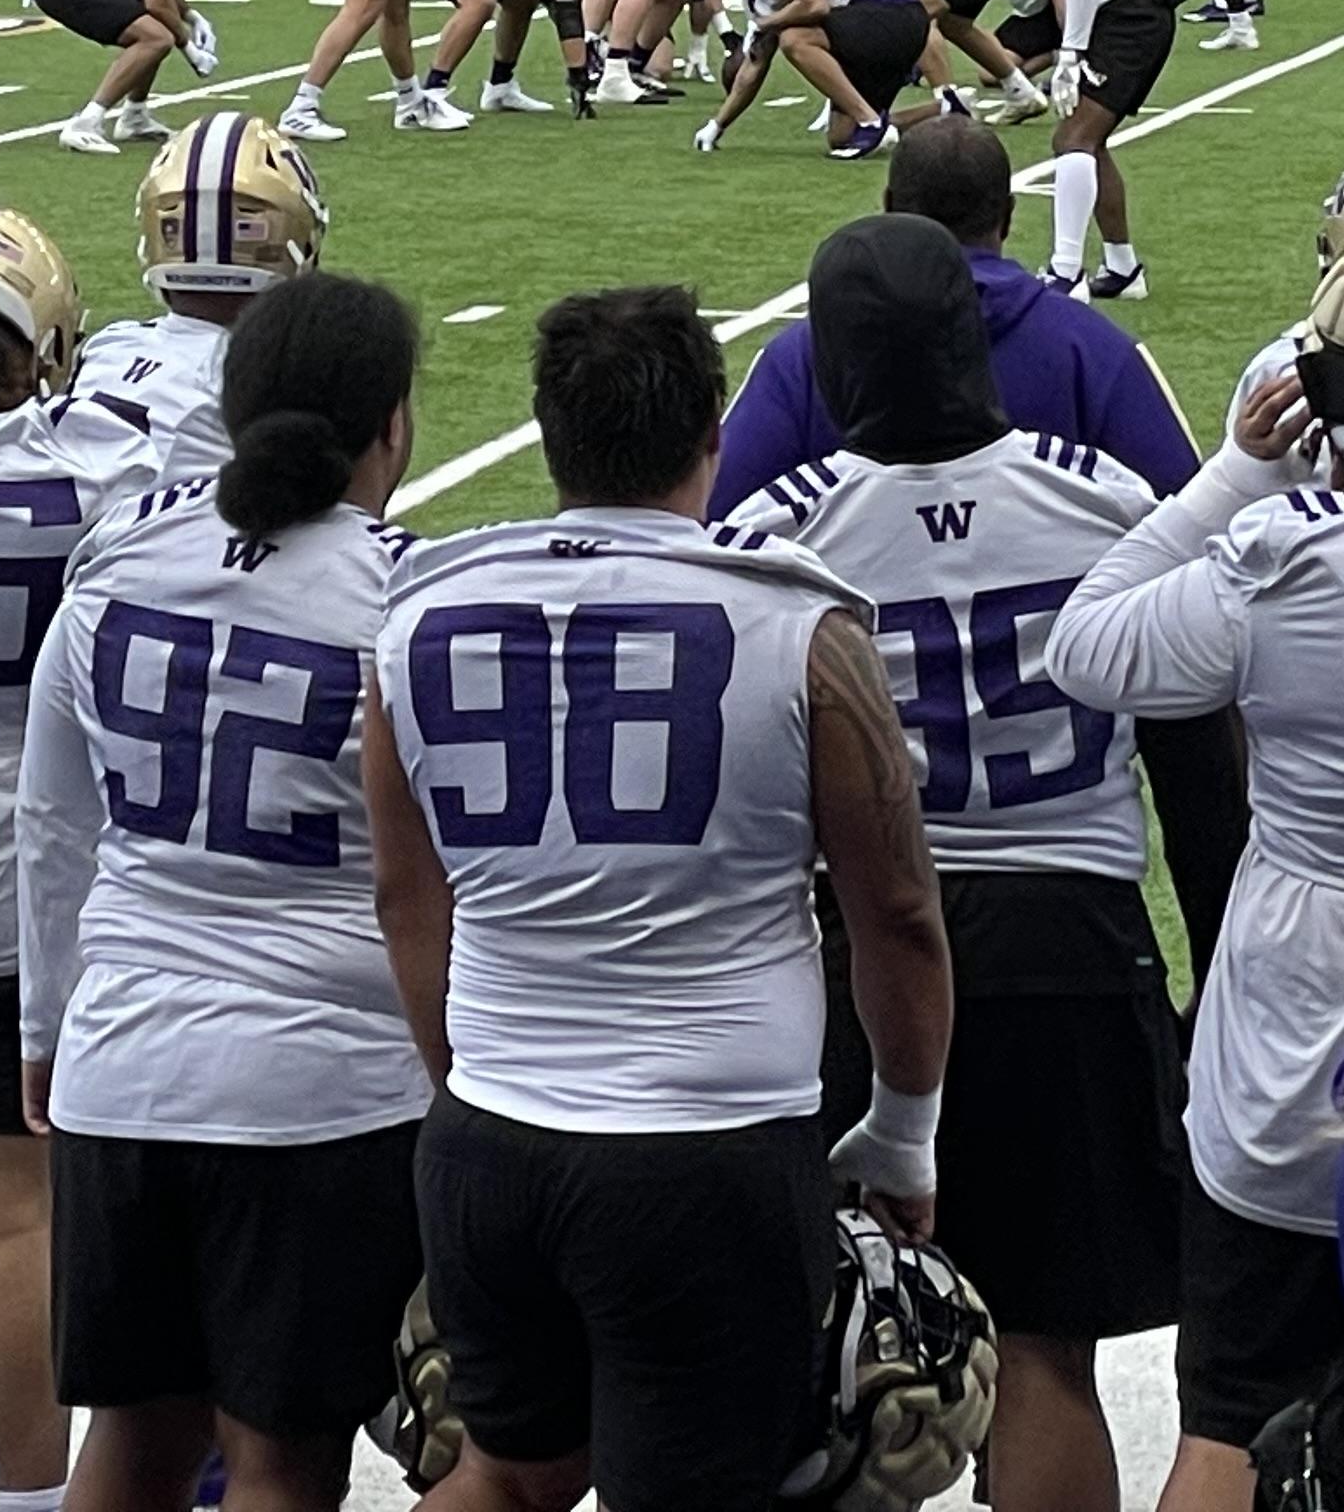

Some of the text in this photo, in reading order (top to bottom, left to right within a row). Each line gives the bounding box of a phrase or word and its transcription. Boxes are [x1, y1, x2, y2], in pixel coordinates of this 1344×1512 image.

[121, 356, 164, 384] W
[916, 500, 977, 544] W
[221, 537, 279, 574] W
[91, 597, 360, 869] 92
[407, 601, 737, 848] 98
